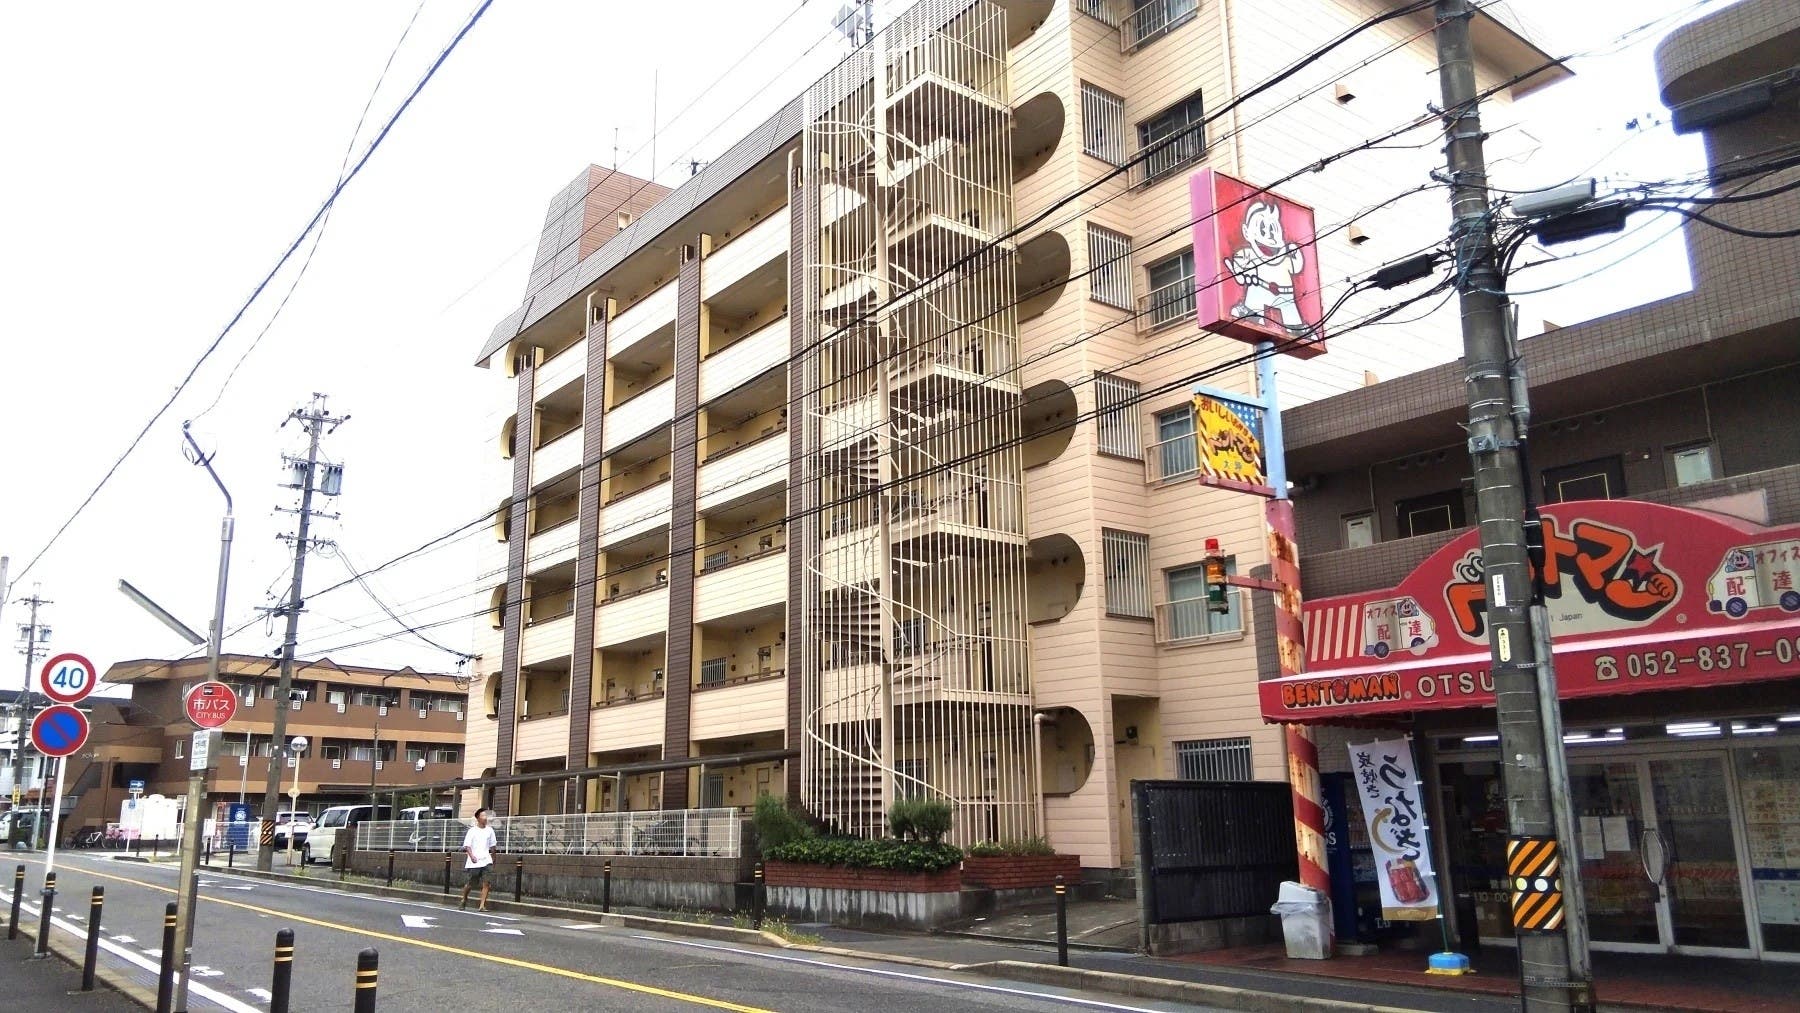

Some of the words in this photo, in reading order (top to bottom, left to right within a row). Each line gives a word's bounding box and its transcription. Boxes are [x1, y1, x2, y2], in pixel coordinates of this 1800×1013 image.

[1366, 604, 1398, 620] オフィス
[53, 666, 84, 688] 40
[1282, 673, 1400, 708] BENTOMAN
[193, 698, 230, 710] 市バス
[196, 711, 211, 719] CITY
[212, 711, 226, 719] BUS
